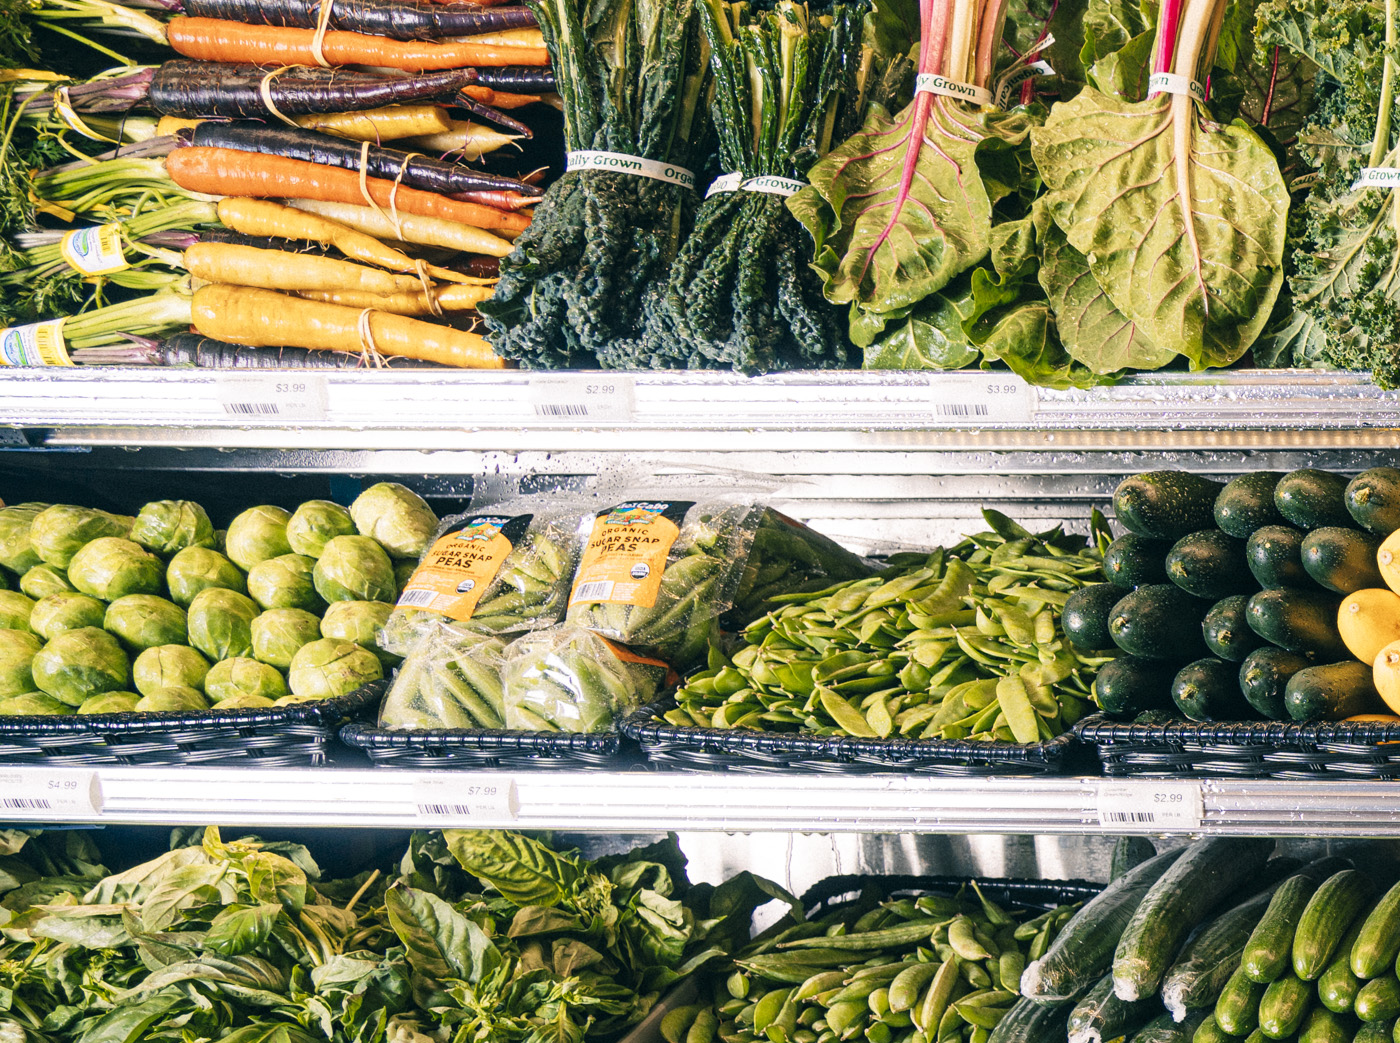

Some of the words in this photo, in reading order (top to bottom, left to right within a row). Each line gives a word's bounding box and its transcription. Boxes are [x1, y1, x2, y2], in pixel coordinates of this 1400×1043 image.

[934, 80, 976, 96] Grown
[594, 157, 642, 170] Grown
[756, 178, 802, 192] Grown
[276, 384, 306, 392] $3.99
[586, 385, 614, 394] $2.99
[987, 385, 1016, 394] $3.99
[602, 527, 649, 537] ORGANIC
[591, 537, 624, 547] SUGAR
[626, 536, 660, 545] SNAP
[446, 543, 484, 552] ORGANIC
[601, 543, 637, 554] PEAS
[431, 551, 462, 560] SUGAR
[463, 552, 492, 562] SNAP
[435, 557, 472, 568] PEAS
[48, 781, 77, 789] $4.99
[468, 787, 497, 795] $7.99
[1154, 794, 1182, 802] $2.99
